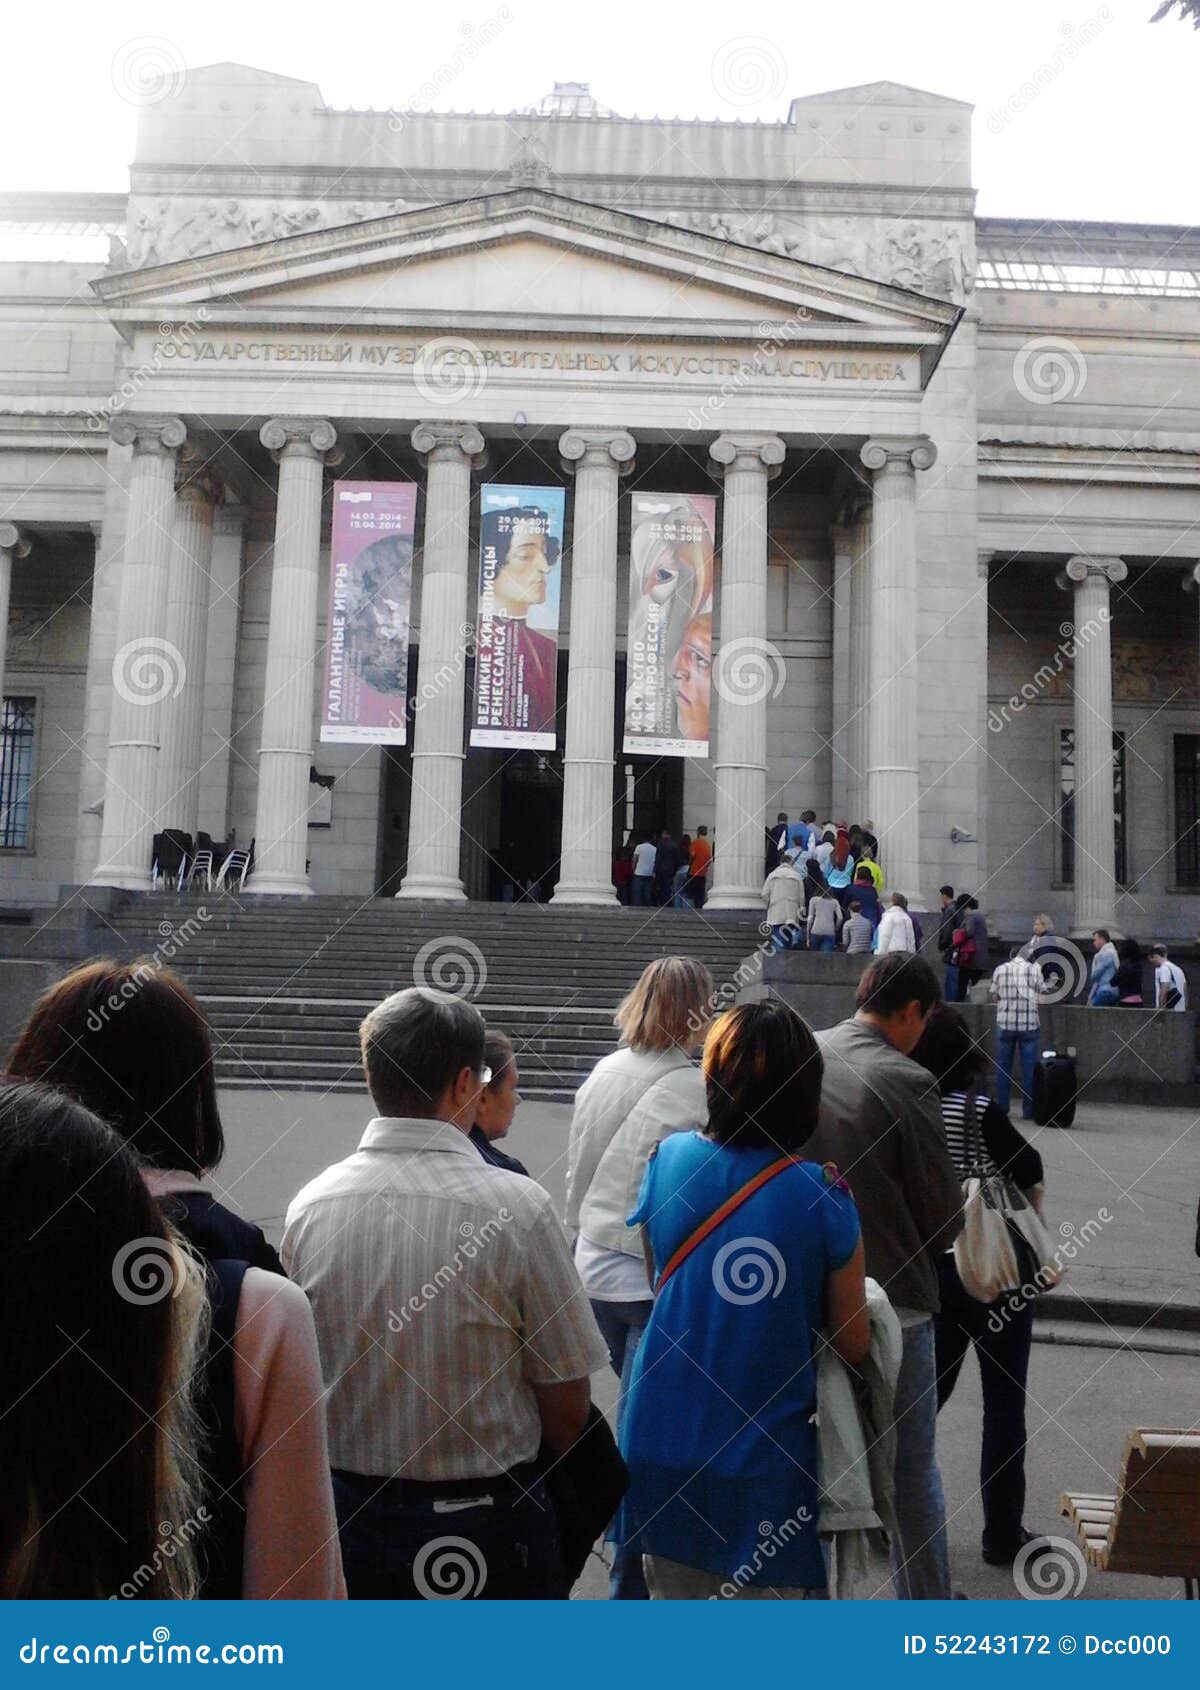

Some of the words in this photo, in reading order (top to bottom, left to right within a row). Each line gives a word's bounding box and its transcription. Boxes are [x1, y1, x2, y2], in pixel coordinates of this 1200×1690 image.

[152, 341, 352, 363] ГОСУДАРСТВЕННЫЙ
[359, 342, 424, 366] МУЗЕЙ
[629, 353, 738, 376] ИСКУССТВ
[333, 563, 348, 611] ИГРЫ
[327, 616, 345, 721] ГАЛАНТНЫЕ
[477, 653, 492, 725] ВЕЛИКИЕ
[490, 625, 506, 726] РЕНЕССАНСА
[630, 641, 645, 732] ИСКУССТВО
[645, 603, 659, 696] ПРОФЕССИЯ
[644, 702, 657, 733] КАК
